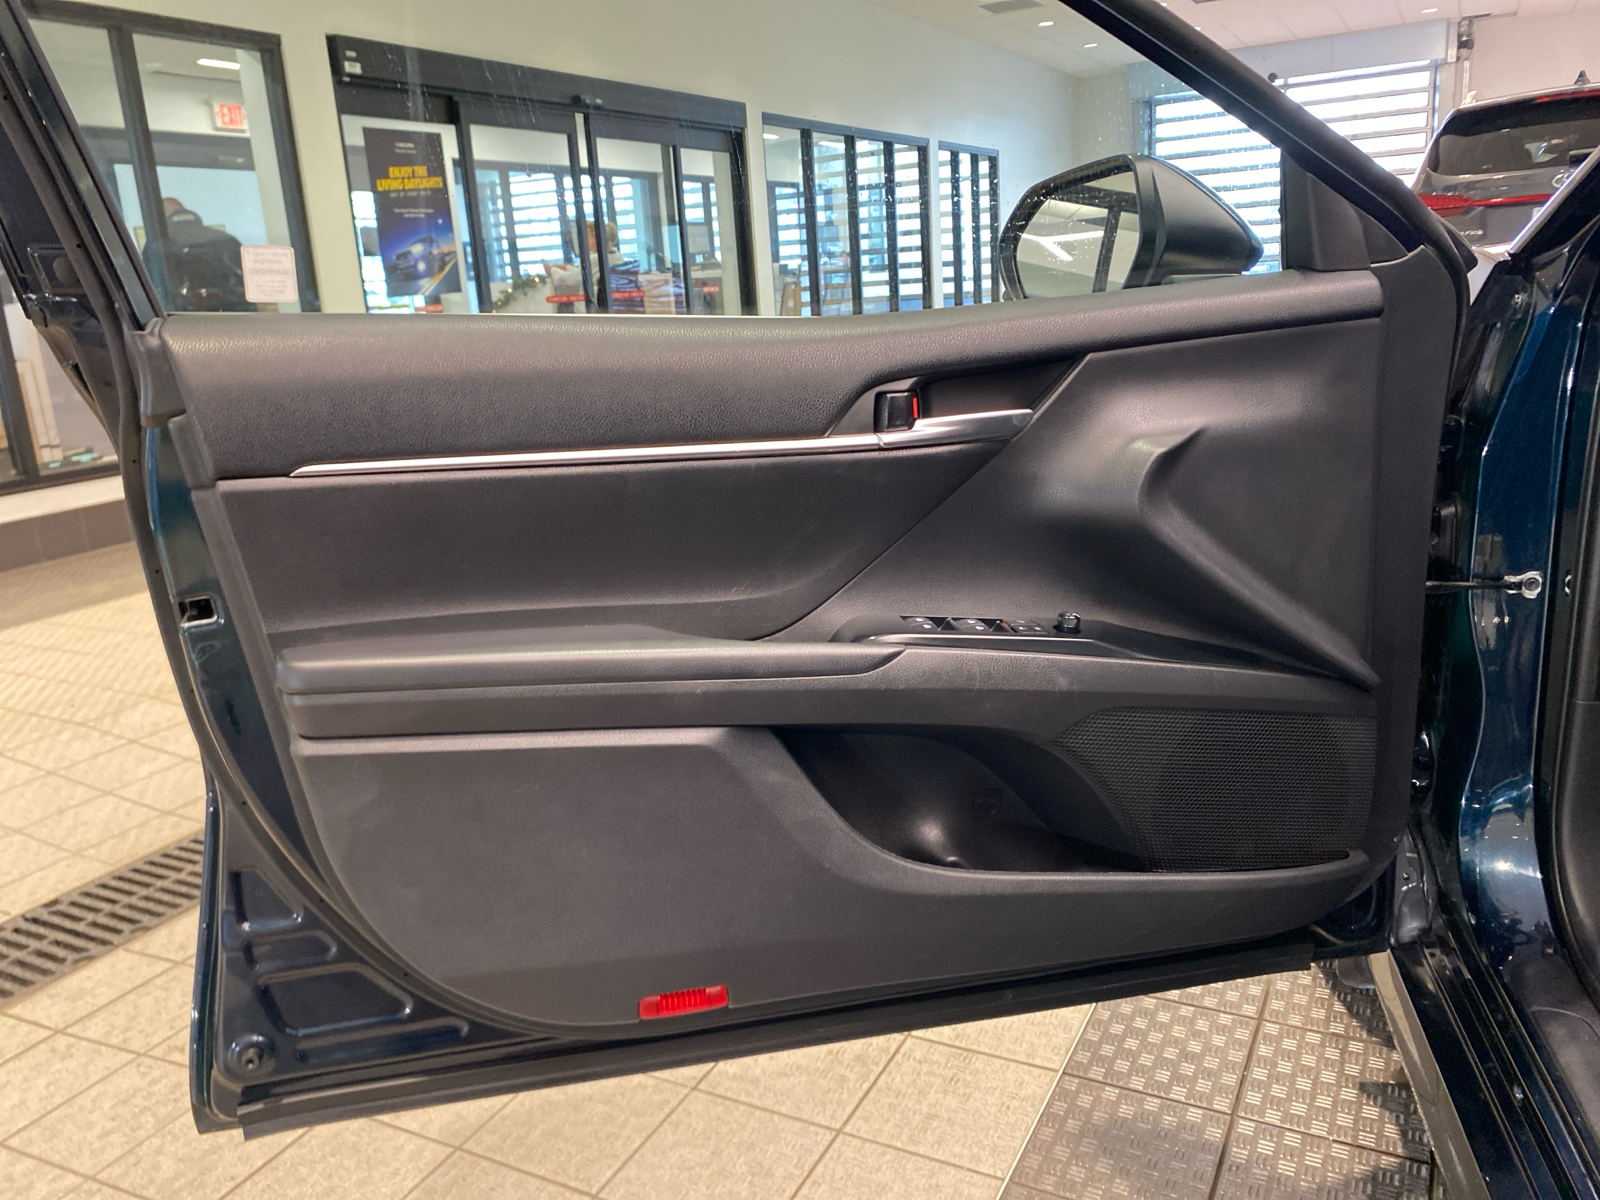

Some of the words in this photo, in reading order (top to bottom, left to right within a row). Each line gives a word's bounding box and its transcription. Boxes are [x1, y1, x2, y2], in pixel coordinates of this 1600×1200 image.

[388, 166, 411, 178] ENJOY
[413, 165, 427, 177] THE
[377, 178, 403, 191] LIVING
[404, 177, 442, 189] DAYLIGHTS
